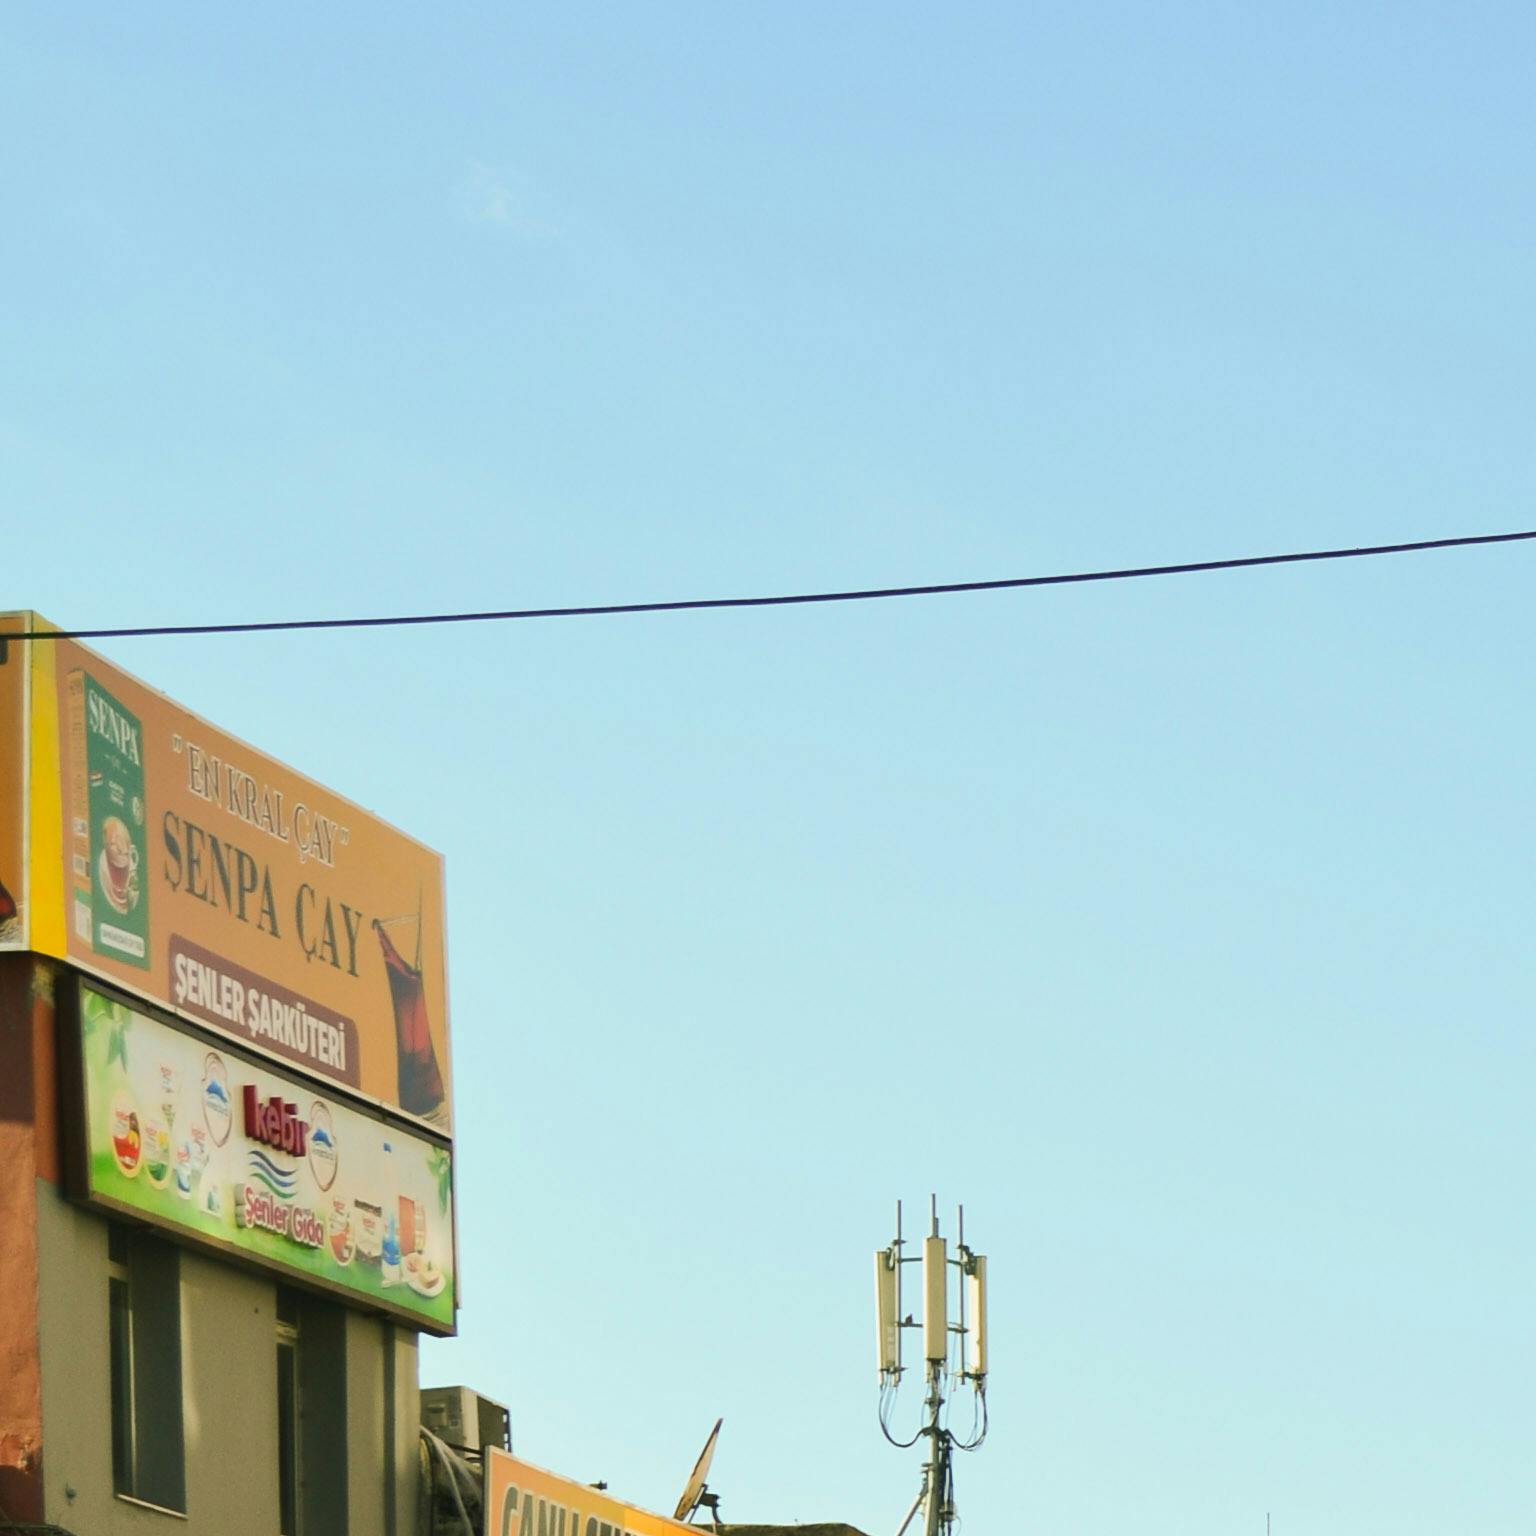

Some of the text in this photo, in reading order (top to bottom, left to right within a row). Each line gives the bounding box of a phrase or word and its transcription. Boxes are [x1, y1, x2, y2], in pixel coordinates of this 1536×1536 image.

[162, 810, 362, 979] ŞENPA ÇAY
[175, 953, 347, 1072] ŞENLER ŞARKÜTERİ
